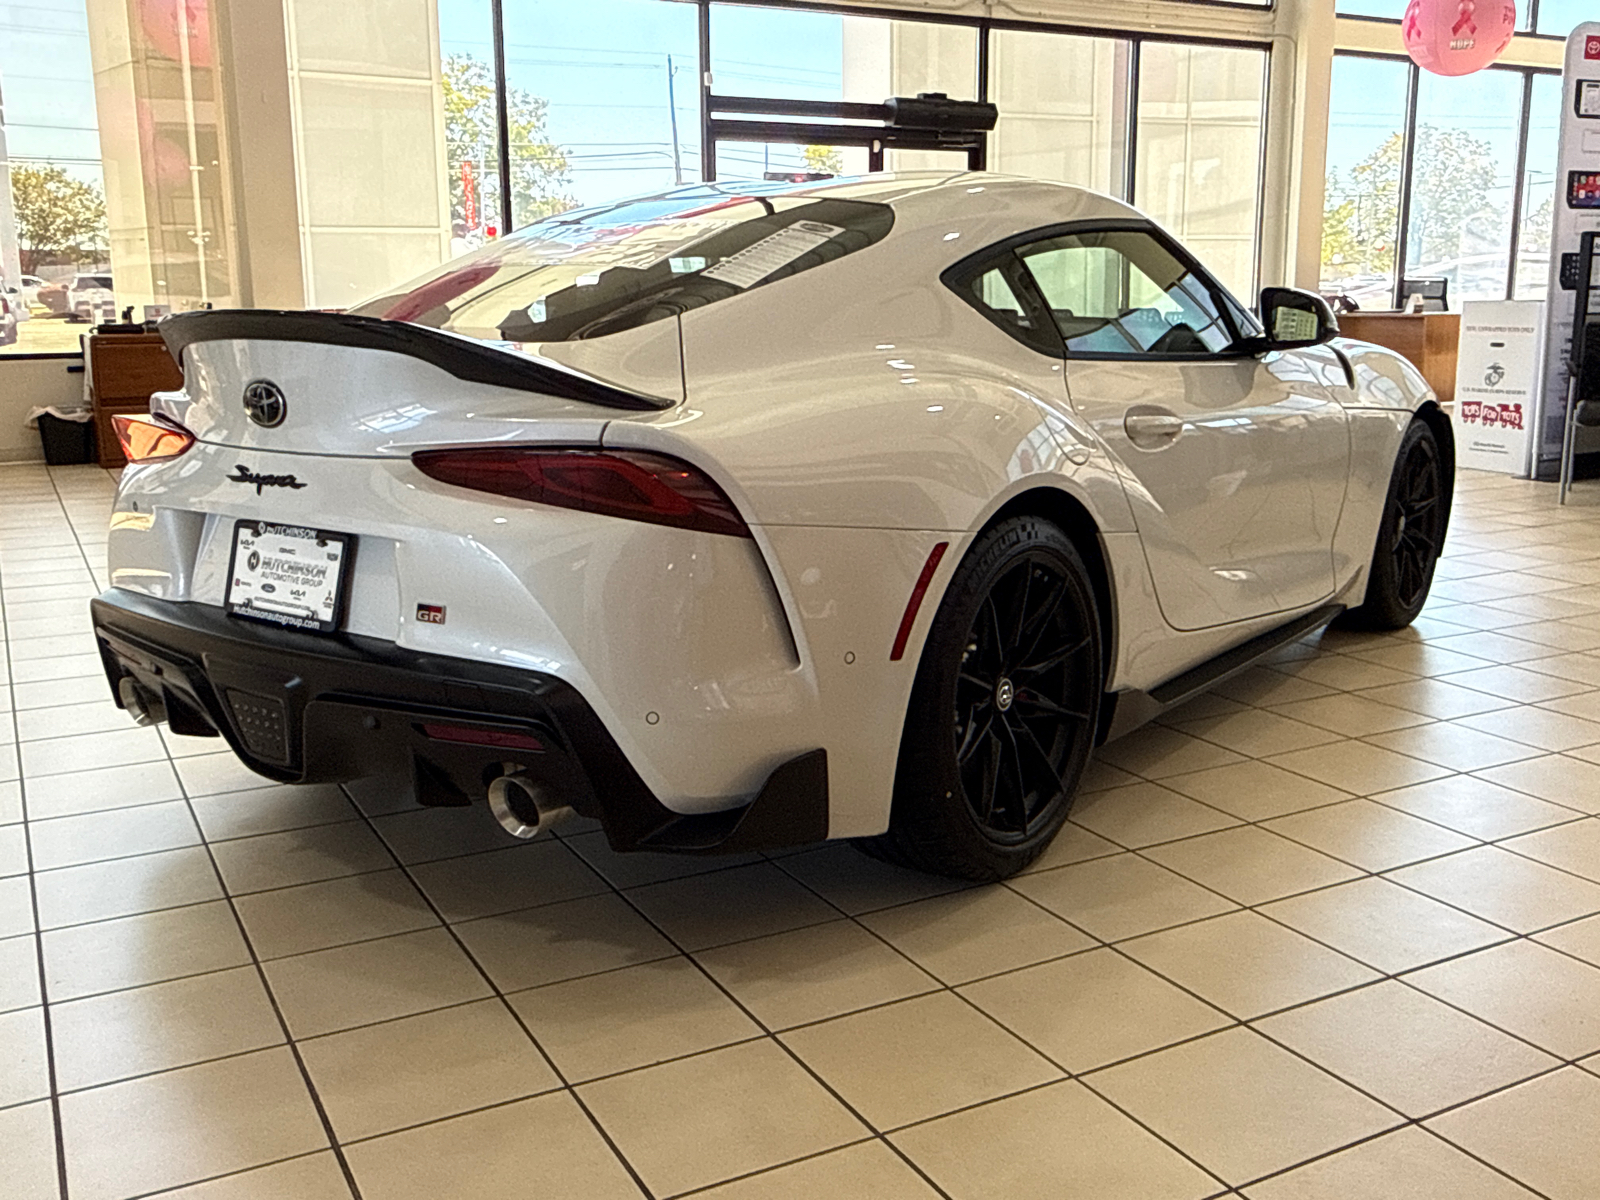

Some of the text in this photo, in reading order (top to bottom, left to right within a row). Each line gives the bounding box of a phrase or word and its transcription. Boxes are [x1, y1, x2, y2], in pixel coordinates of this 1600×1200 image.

[1463, 405, 1520, 424] TOYS FOR TOTS
[226, 464, 308, 496] Supra
[267, 525, 318, 540] HUTCHINSON
[967, 527, 1021, 585] MICHELIN
[261, 556, 328, 580] HUTCHINSON
[261, 571, 300, 585] AUTOMOTIVE
[301, 578, 324, 587] GROUP
[417, 610, 442, 623] GR
